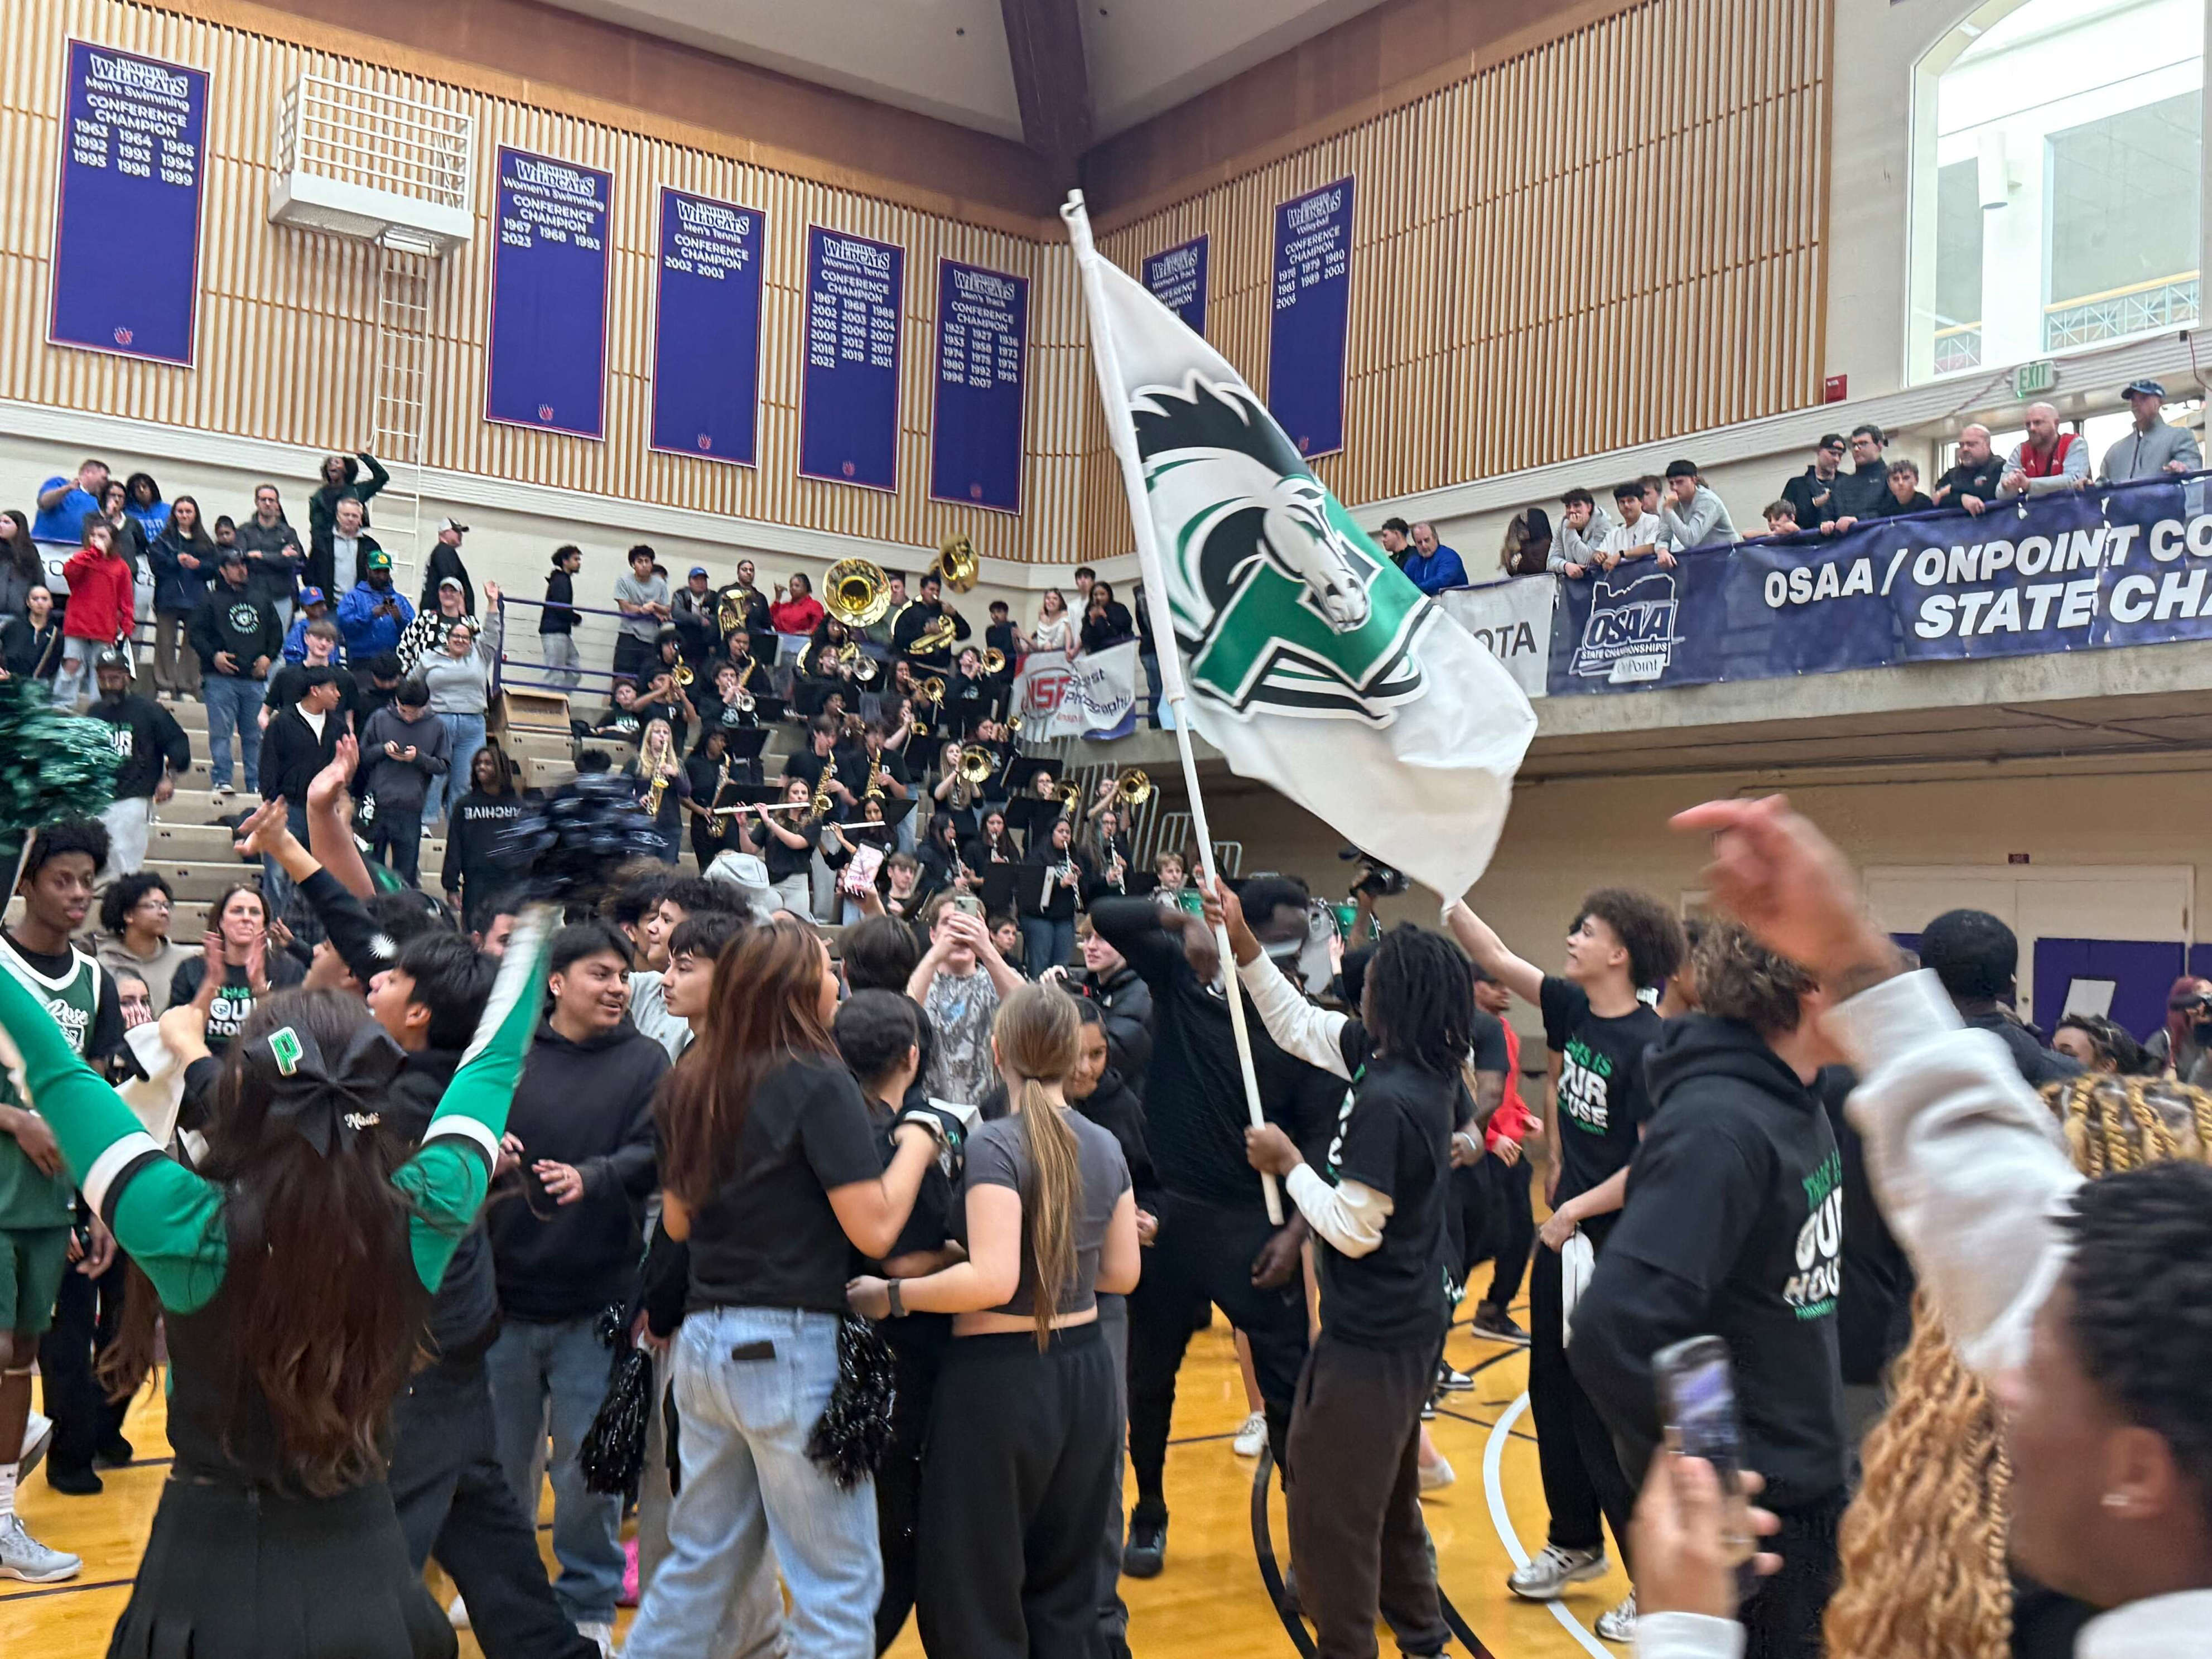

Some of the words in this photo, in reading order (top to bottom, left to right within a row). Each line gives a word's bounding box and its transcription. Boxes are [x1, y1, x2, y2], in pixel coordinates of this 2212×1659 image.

[90, 53, 188, 98] WILDCATS
[85, 75, 122, 94] Men's
[124, 86, 190, 112] Swimming
[87, 93, 187, 128] CONFERENCE
[95, 109, 177, 138] CHAMPION
[75, 118, 108, 138] 1963
[118, 128, 153, 148] 1964
[162, 139, 194, 157] 1965
[73, 148, 107, 167] 1995
[160, 168, 192, 186] 1999
[74, 133, 107, 153] 1992
[119, 143, 151, 162] 1993
[161, 153, 194, 172] 1994
[515, 158, 595, 197] WILDCATS
[503, 176, 550, 197] Women's
[553, 189, 605, 212] Swimming
[513, 194, 594, 223] CONFERENCE
[520, 208, 586, 234] CHAMPION
[677, 198, 749, 235] WILDCATS
[574, 233, 600, 250] 1993
[674, 233, 749, 261] CONFERENCE
[683, 221, 710, 237] Men's
[712, 227, 741, 244] Tennis
[1285, 224, 1340, 255] CONFERENCE
[681, 247, 741, 271] CHAMPION
[823, 236, 890, 271] WILDCATS
[1289, 239, 1334, 265] CHAMPION
[665, 255, 693, 272] 2002
[697, 263, 724, 279] 2003
[822, 255, 861, 274] Women's
[864, 266, 890, 281] Tennis
[821, 269, 889, 295] CONFERENCE
[827, 282, 883, 304] CHAMPION
[812, 303, 837, 319] 2002
[871, 317, 895, 331] 2004
[951, 301, 1013, 324] CONFERENCE
[957, 313, 1008, 334] CHAMPION
[811, 315, 836, 331] 2005
[870, 329, 894, 344] 2007
[871, 341, 893, 355] 2017
[2020, 363, 2048, 389] EXIT
[1764, 557, 1872, 609] OSAA
[1881, 548, 1907, 596] /
[1912, 524, 2139, 586] ONPOINT
[1914, 578, 2097, 639] STATE
[1584, 600, 1674, 650] OSAA
[464, 806, 522, 819] ARCHIVE
[268, 1026, 303, 1076] P
